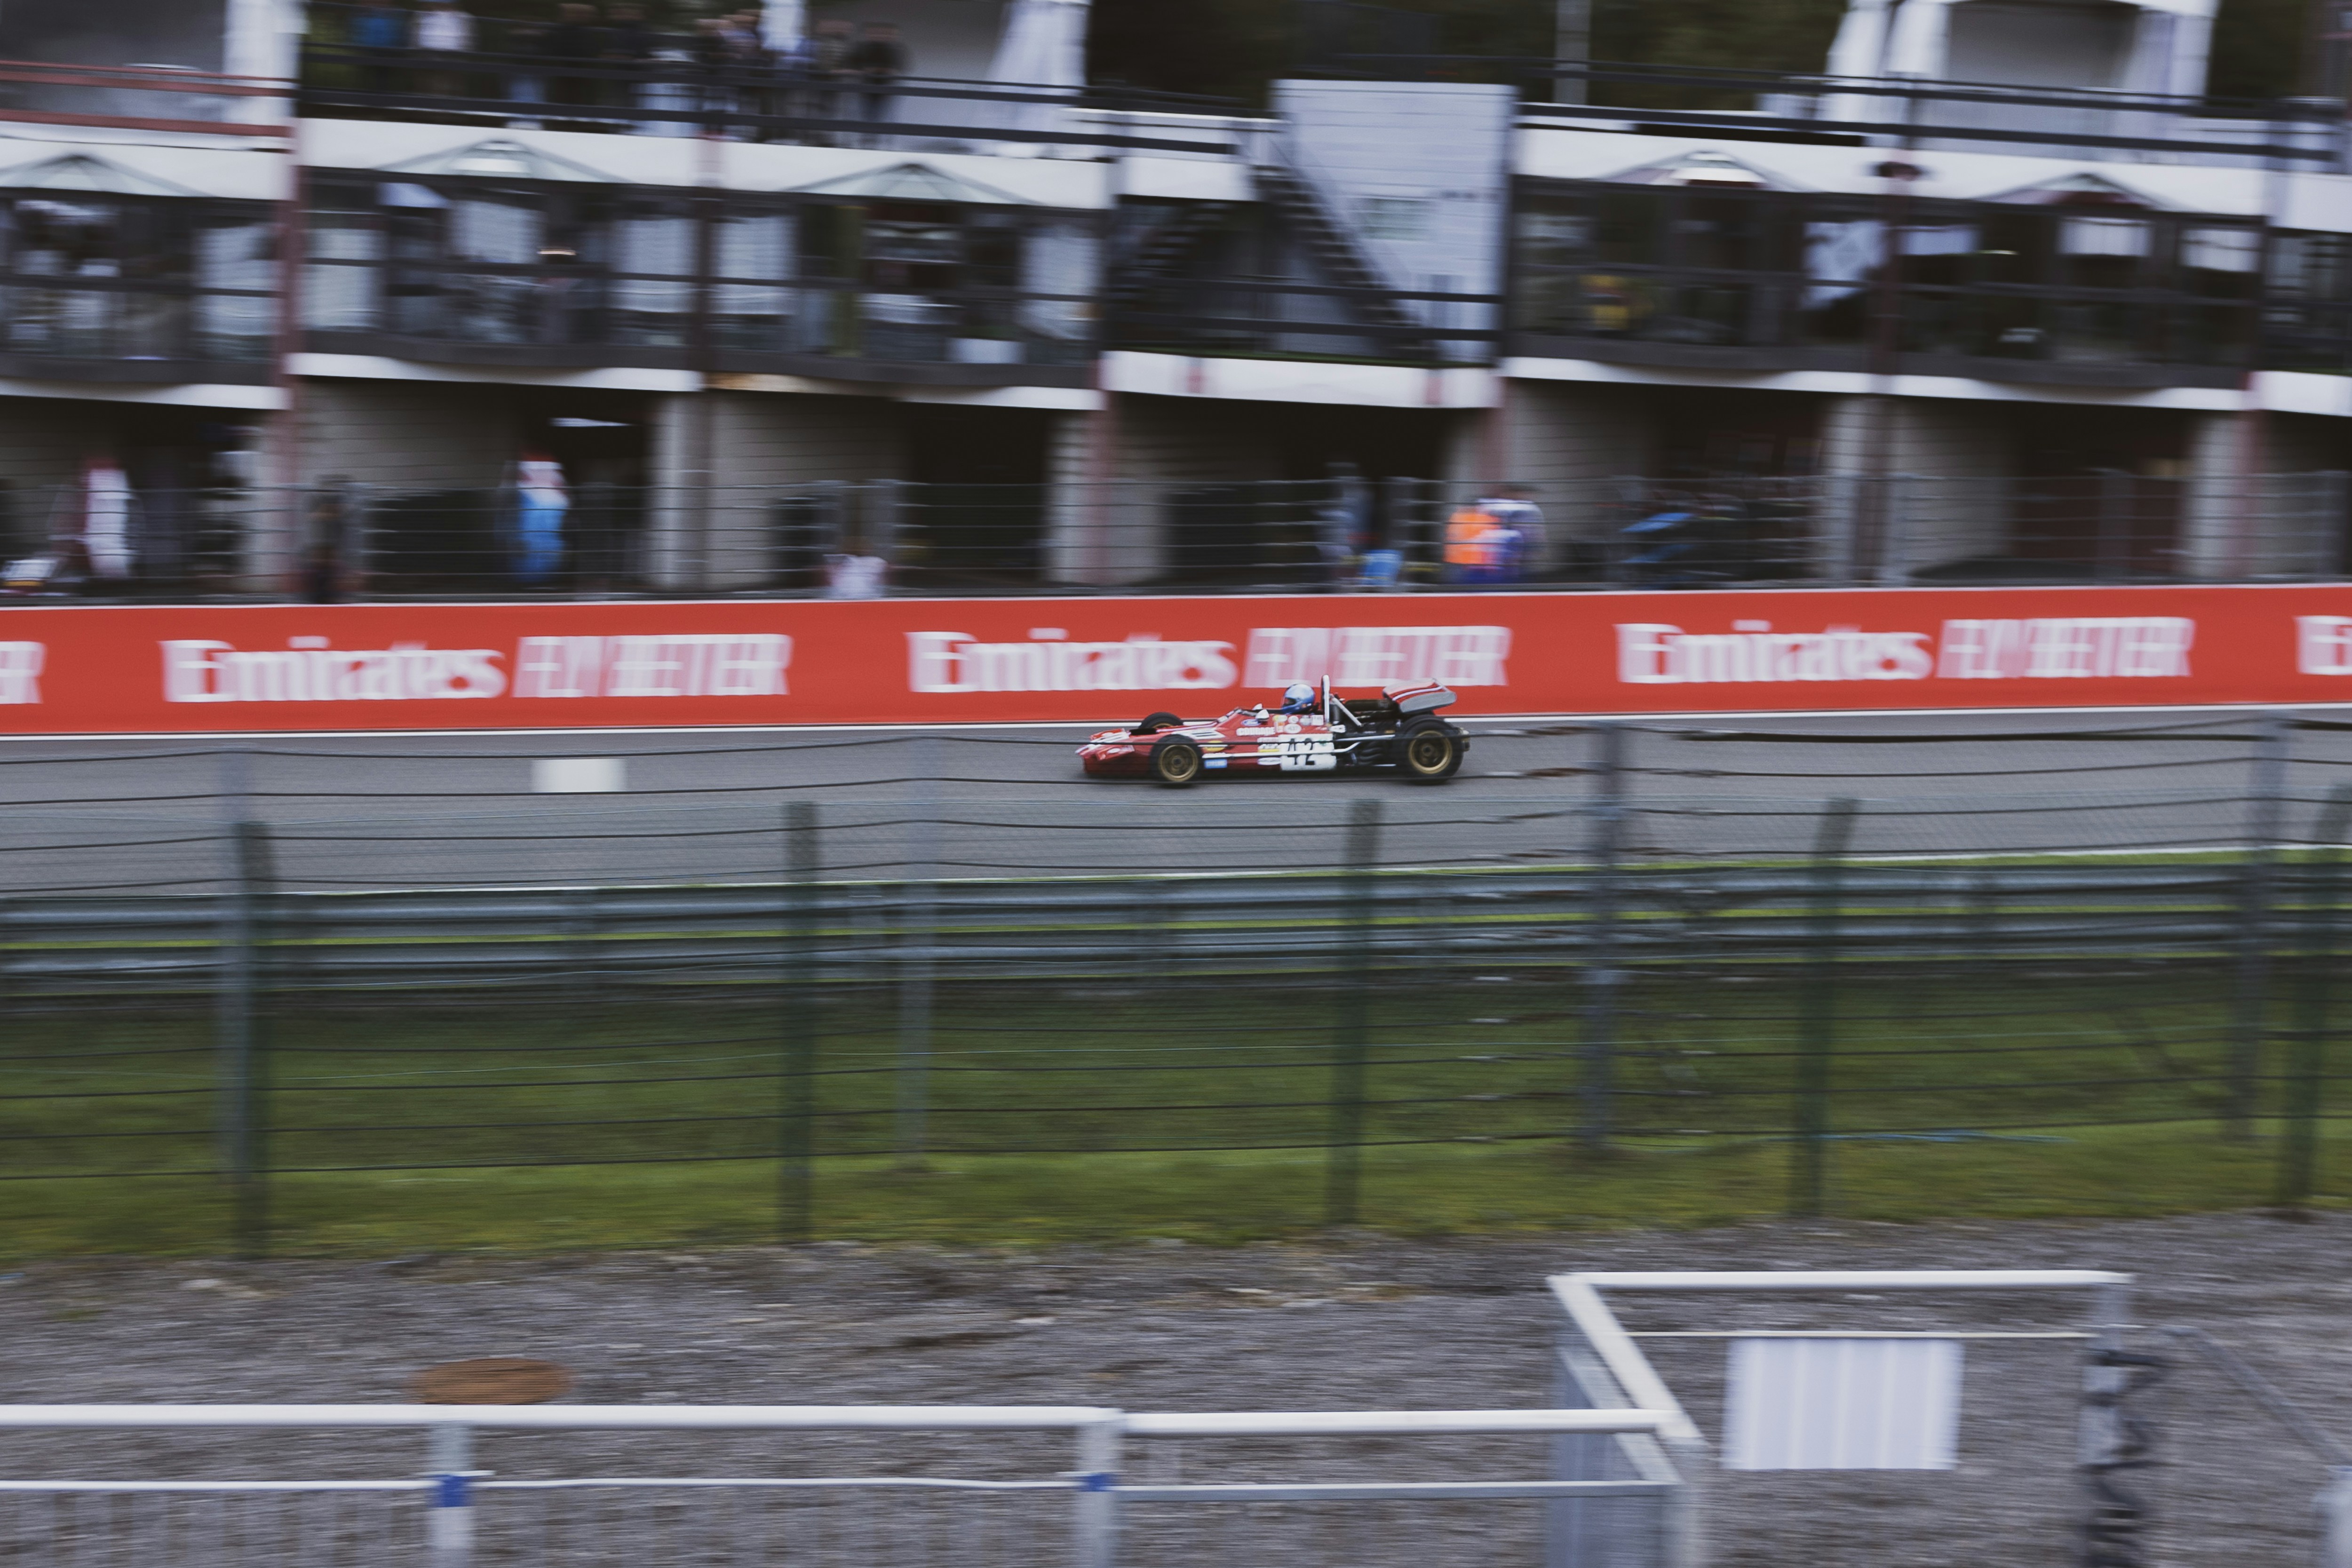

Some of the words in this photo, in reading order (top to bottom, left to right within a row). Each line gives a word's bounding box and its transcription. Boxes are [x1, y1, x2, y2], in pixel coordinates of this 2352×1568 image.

[157, 635, 507, 702] Emirates
[904, 627, 1238, 692] Emirates
[1613, 619, 1933, 684] Emirates
[1287, 738, 1315, 765] 42
